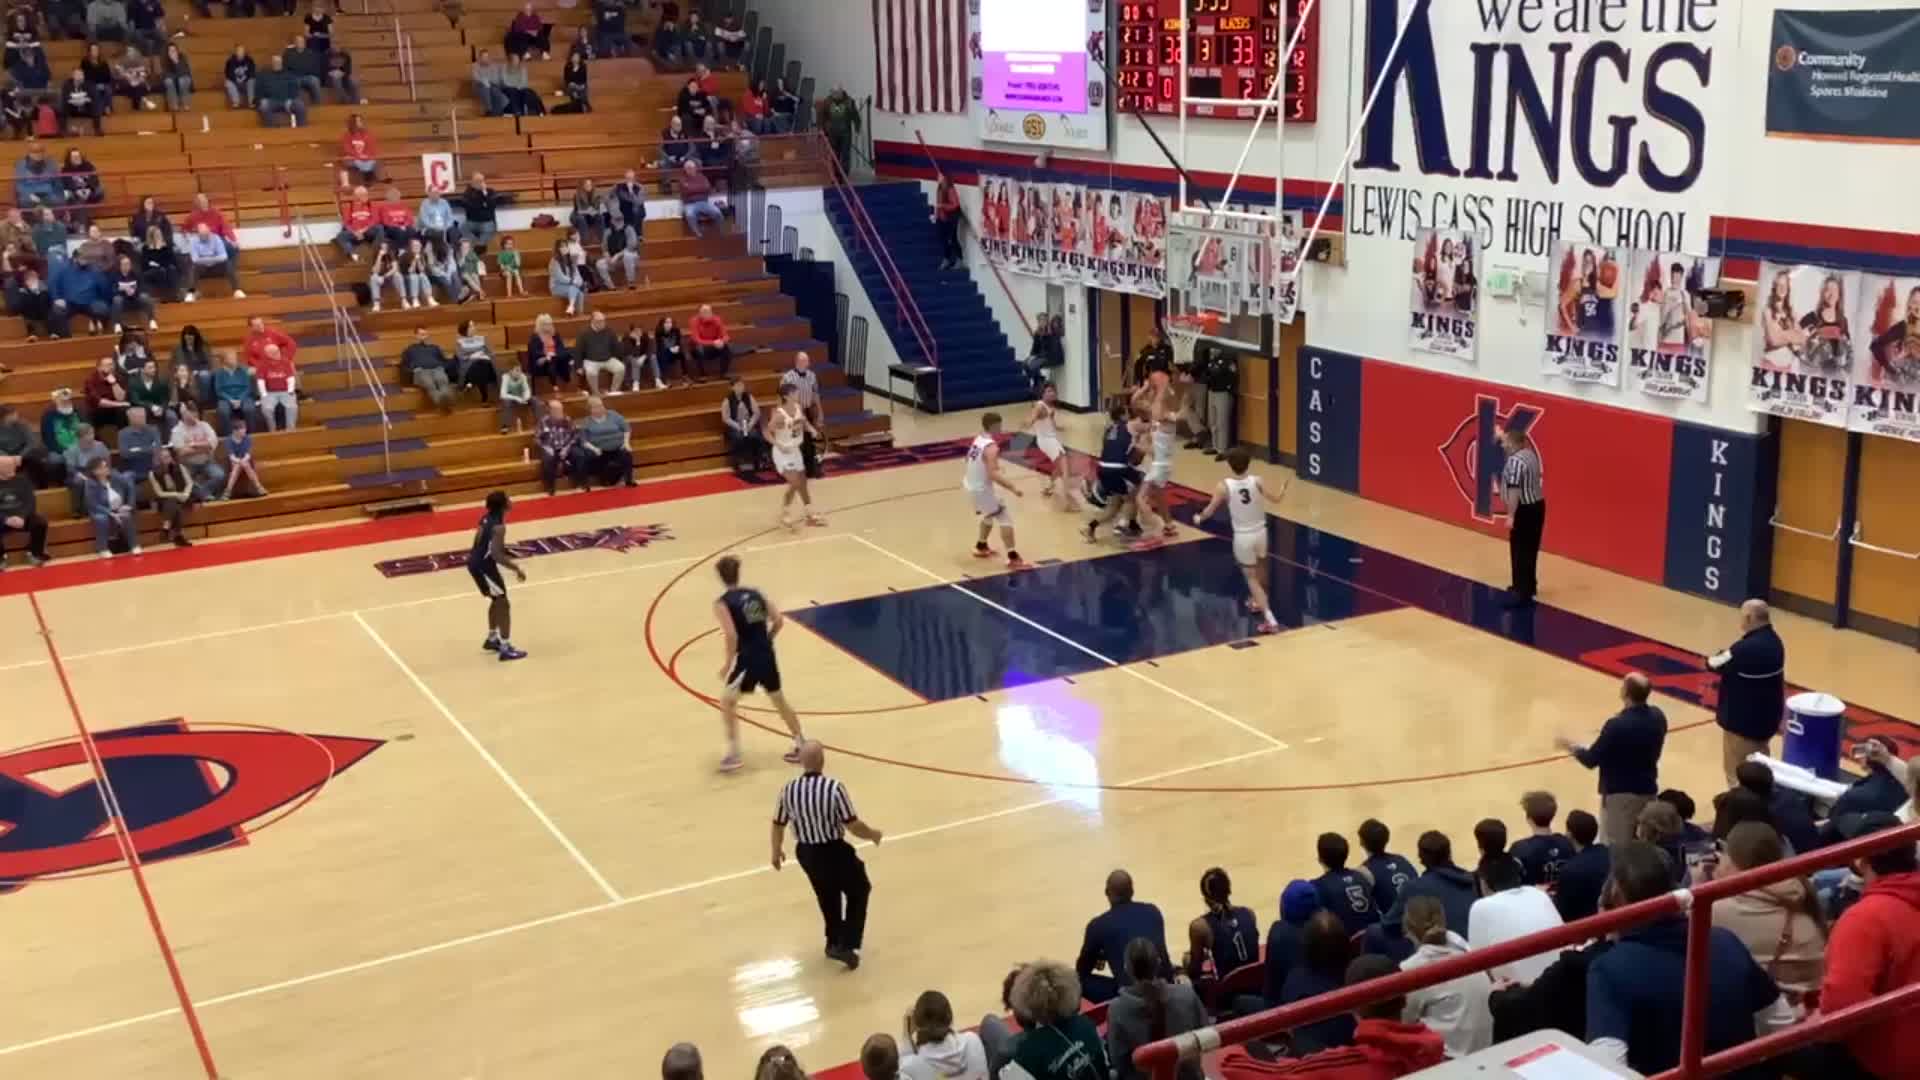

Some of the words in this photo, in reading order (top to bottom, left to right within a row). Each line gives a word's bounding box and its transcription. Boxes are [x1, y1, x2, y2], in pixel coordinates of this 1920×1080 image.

[1478, 0, 1543, 33] we
[1554, 0, 1627, 33] are
[1641, 0, 1717, 33] the
[1232, 36, 1254, 64] 33
[1799, 50, 1866, 70] Community
[1353, 0, 1713, 193] KINGS
[428, 160, 448, 192] C
[1350, 184, 1422, 241] LEWIS
[1432, 192, 1494, 249] CASS
[1505, 198, 1563, 256] HIGH
[1579, 204, 1687, 255] SCHOOL
[1411, 311, 1475, 338] KINGS
[1545, 334, 1619, 363] KINGS
[1630, 348, 1707, 378] KINGS
[1751, 367, 1847, 401] KINGS
[1853, 384, 1920, 414] KIN
[1309, 357, 1322, 476] CASS
[1238, 488, 1252, 504] 3
[1704, 439, 1729, 591] KINGS
[1345, 885, 1368, 912] 5
[1232, 931, 1248, 962] 1
